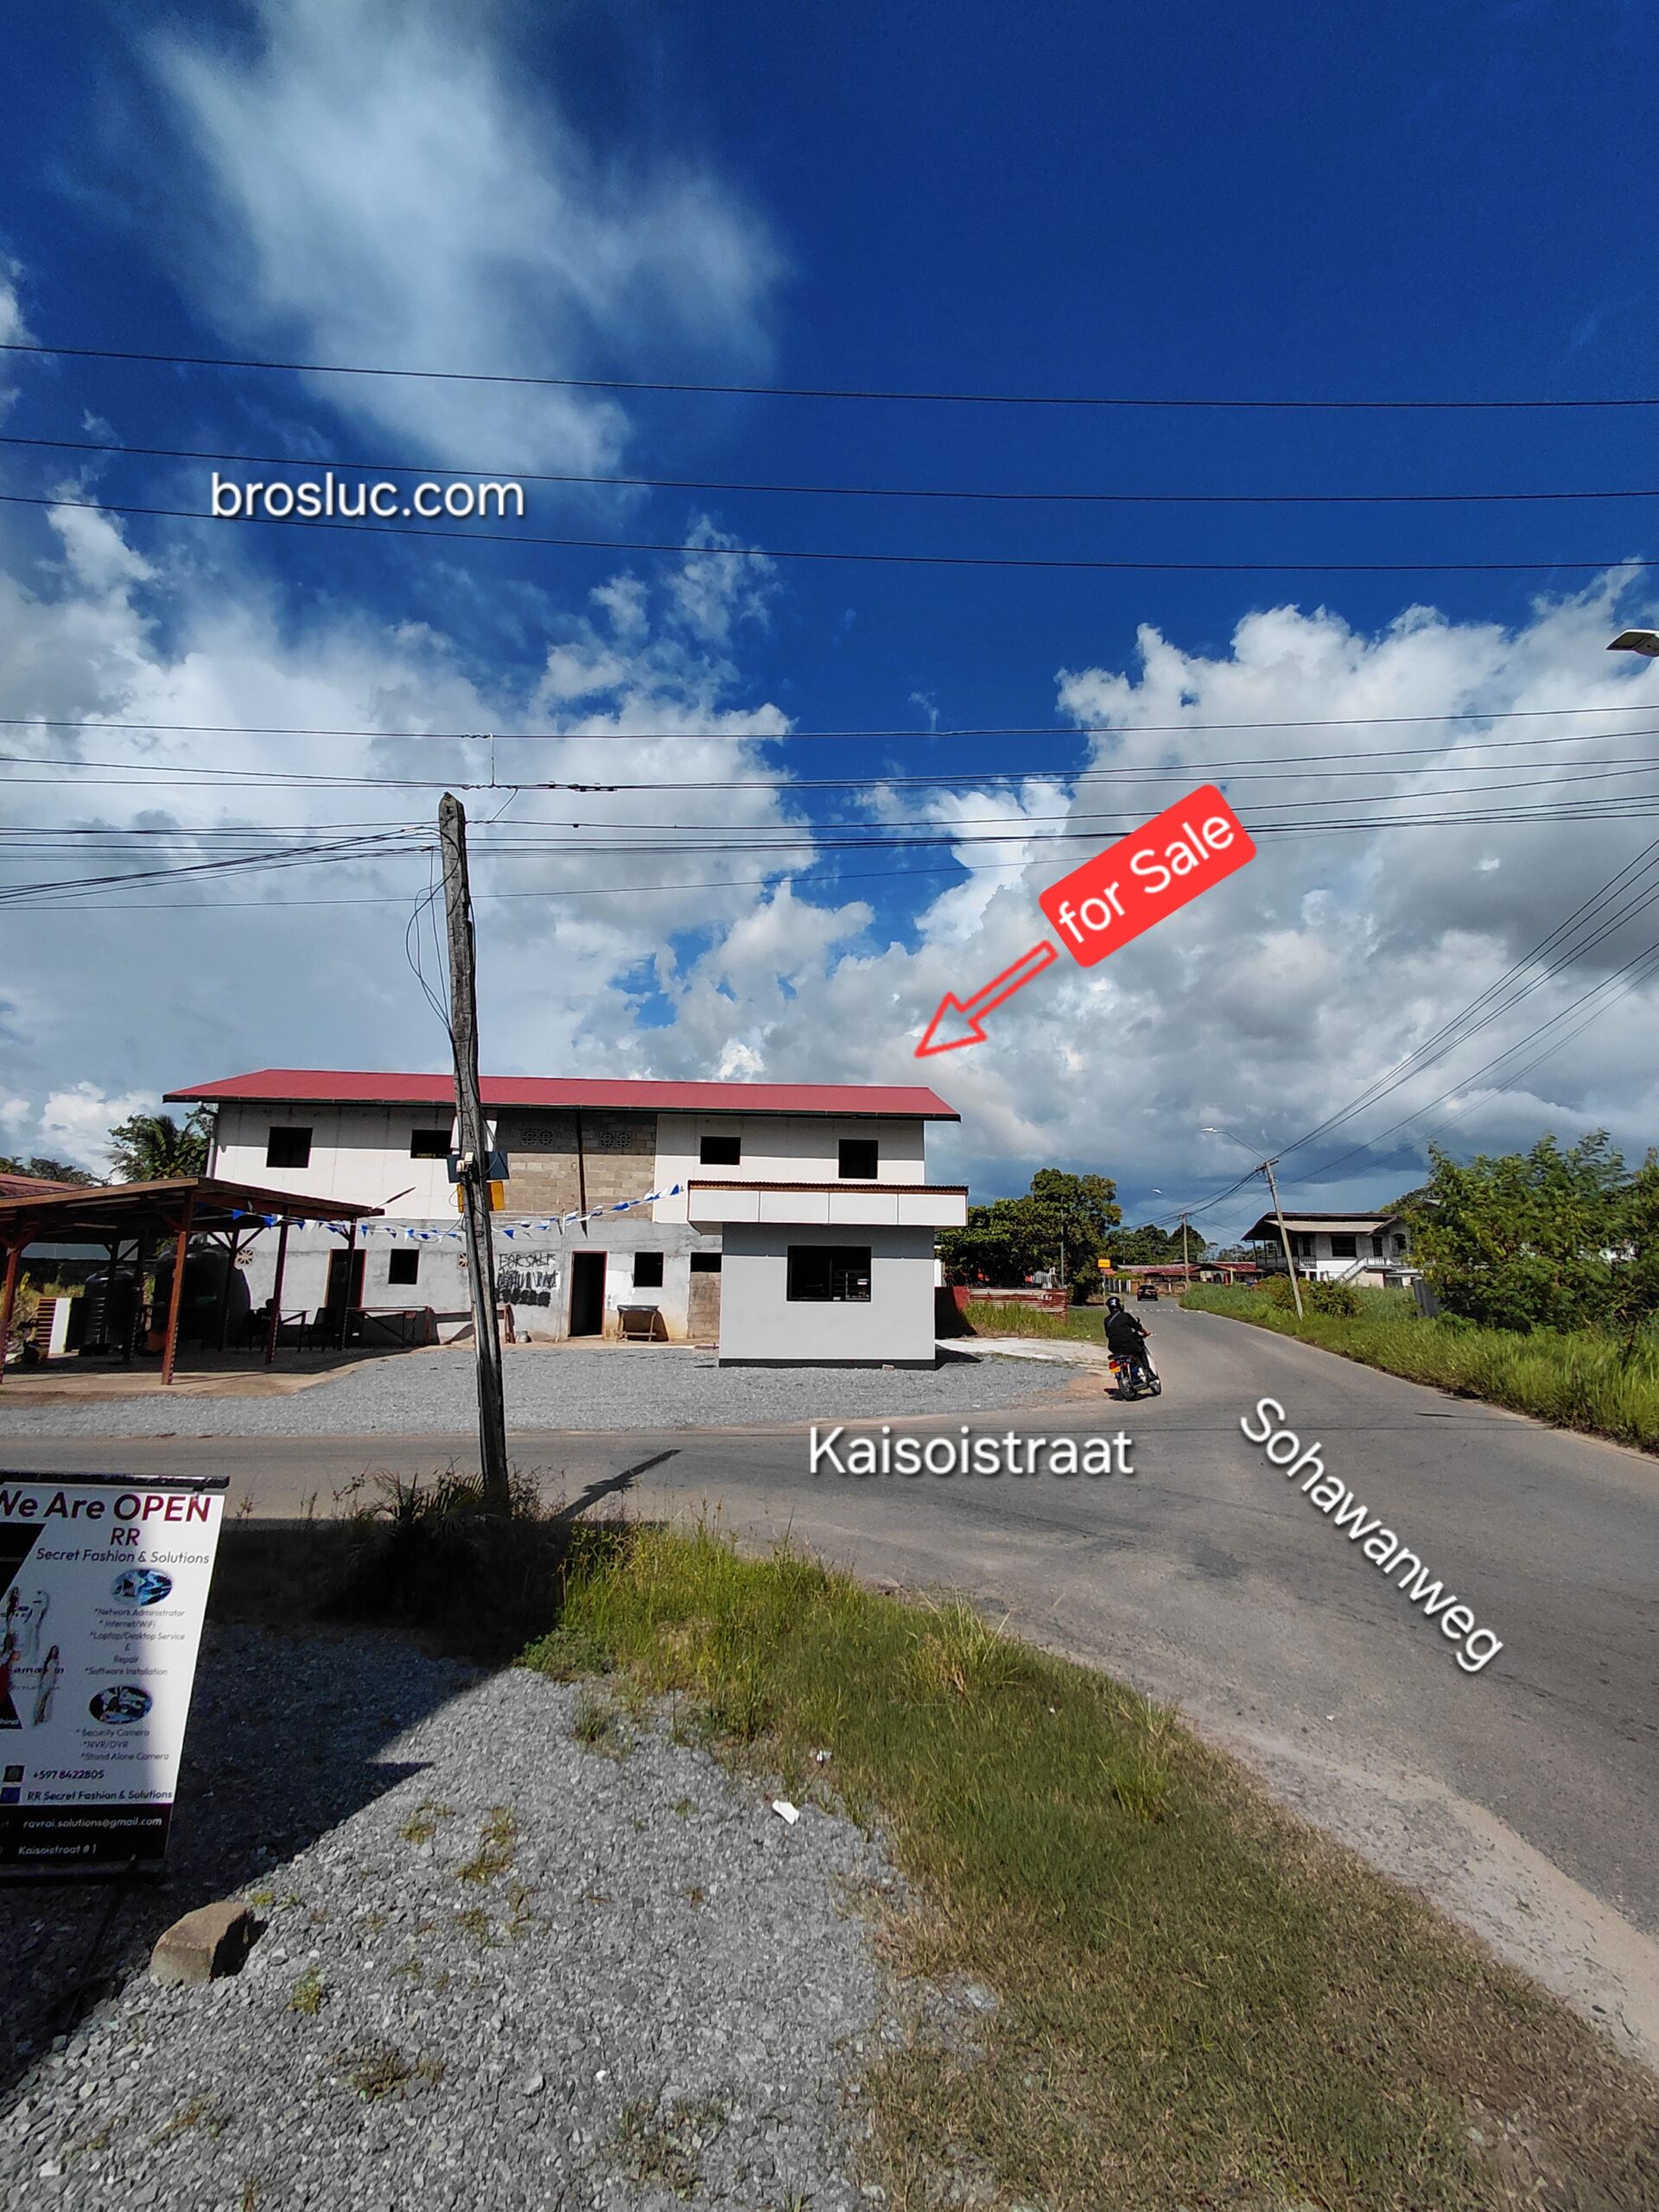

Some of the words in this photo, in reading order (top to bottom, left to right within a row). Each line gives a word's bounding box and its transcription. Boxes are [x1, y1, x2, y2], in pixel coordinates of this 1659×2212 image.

[43, 1491, 105, 1519] Are
[113, 1494, 211, 1522] OPEN
[110, 1528, 141, 1546] RR
[36, 1548, 79, 1560] Secret
[82, 1549, 135, 1563] Fashion
[137, 1550, 147, 1562] &
[150, 1551, 209, 1564] Solutions
[132, 1608, 185, 1617] Administrator
[113, 1655, 139, 1664] Repair
[27, 1791, 41, 1800] RR
[43, 1790, 76, 1800] Secret
[79, 1790, 117, 1800] Fashion
[128, 1789, 173, 1799] Solutions
